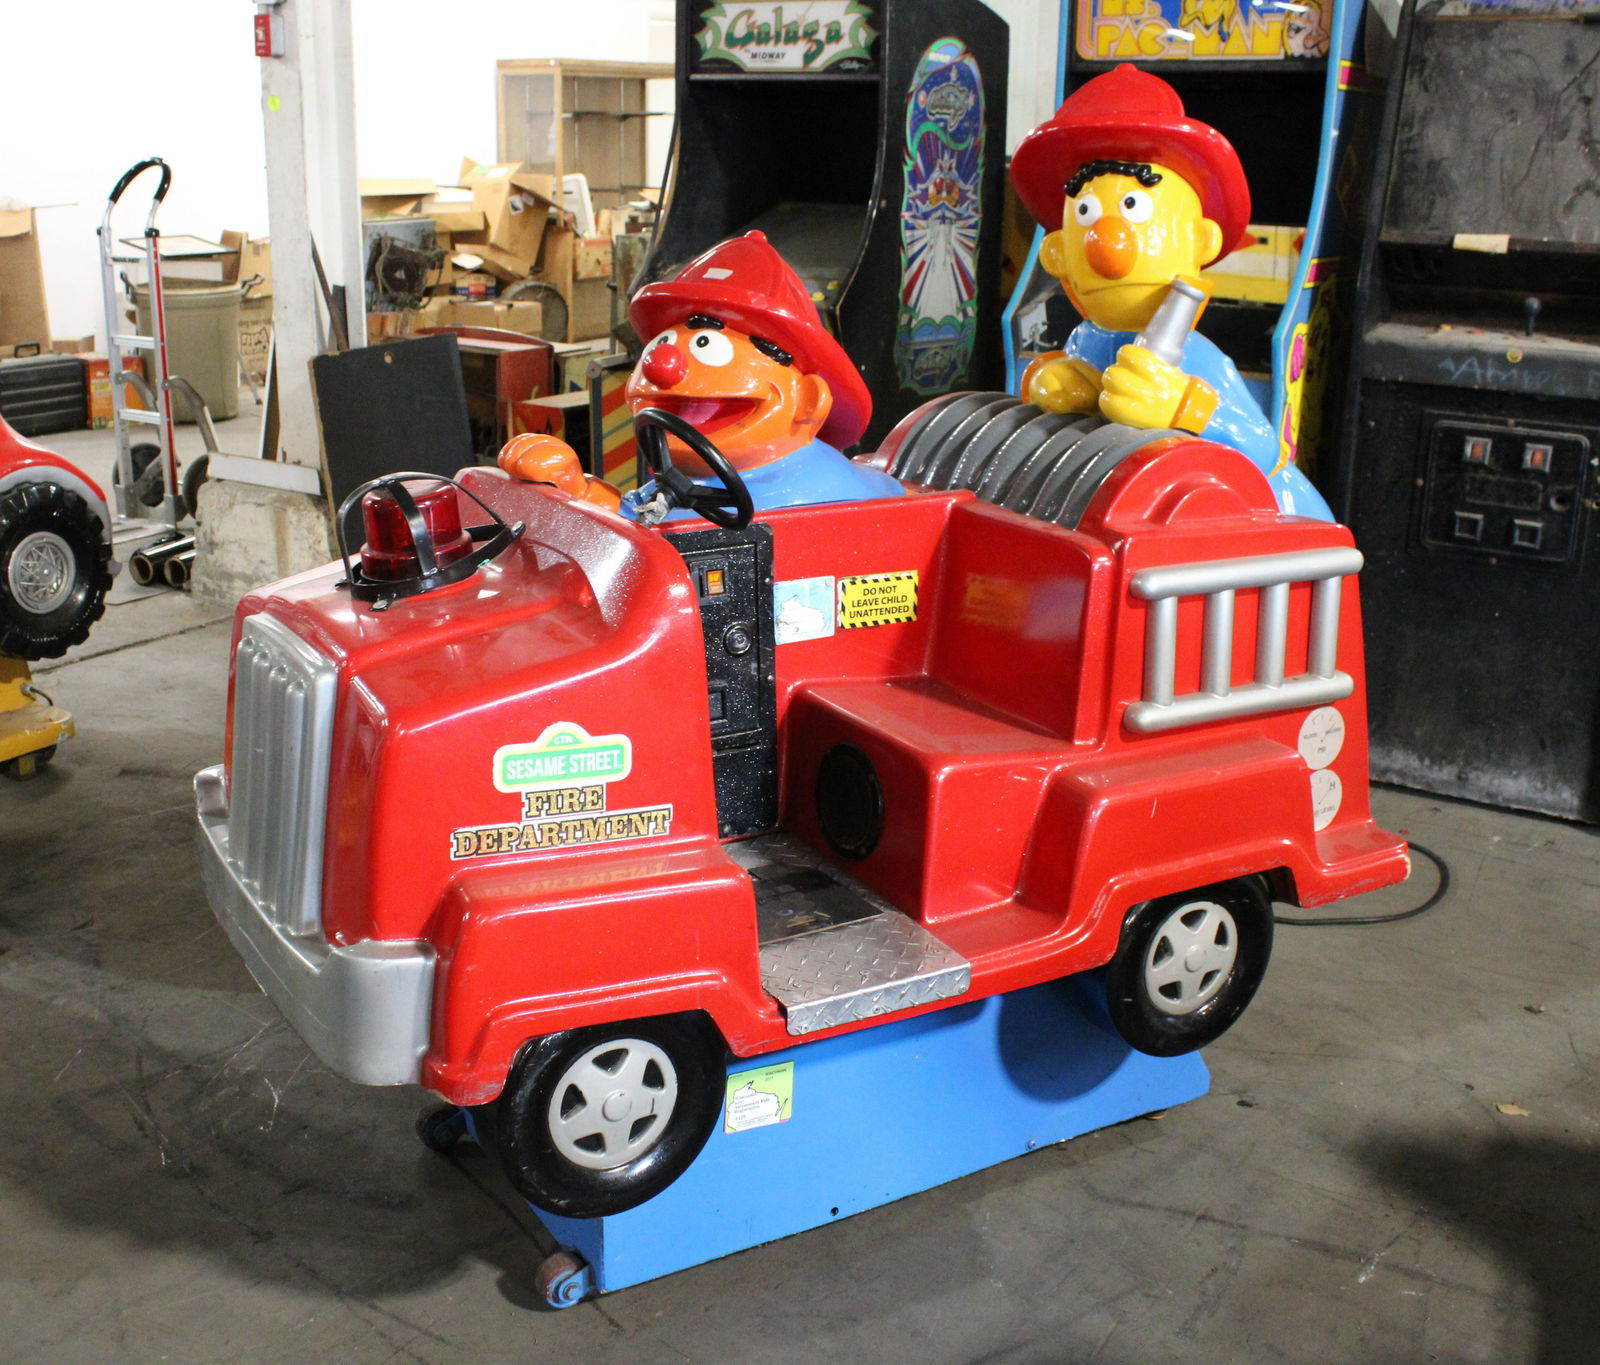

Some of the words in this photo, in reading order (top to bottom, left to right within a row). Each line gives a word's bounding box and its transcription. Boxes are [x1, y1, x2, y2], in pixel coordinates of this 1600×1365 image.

[723, 6, 843, 70] Galaga
[750, 51, 786, 60] MIDWAY
[851, 597, 880, 608] LEAVE
[881, 594, 908, 605] CHILD
[863, 588, 877, 596] DO
[879, 585, 897, 595] NOT
[849, 605, 910, 619] UNATTENDED
[506, 754, 566, 780] SESAME
[570, 749, 621, 773] STREET
[525, 784, 605, 818] FIRE
[453, 807, 671, 859] DEPARTMENT
